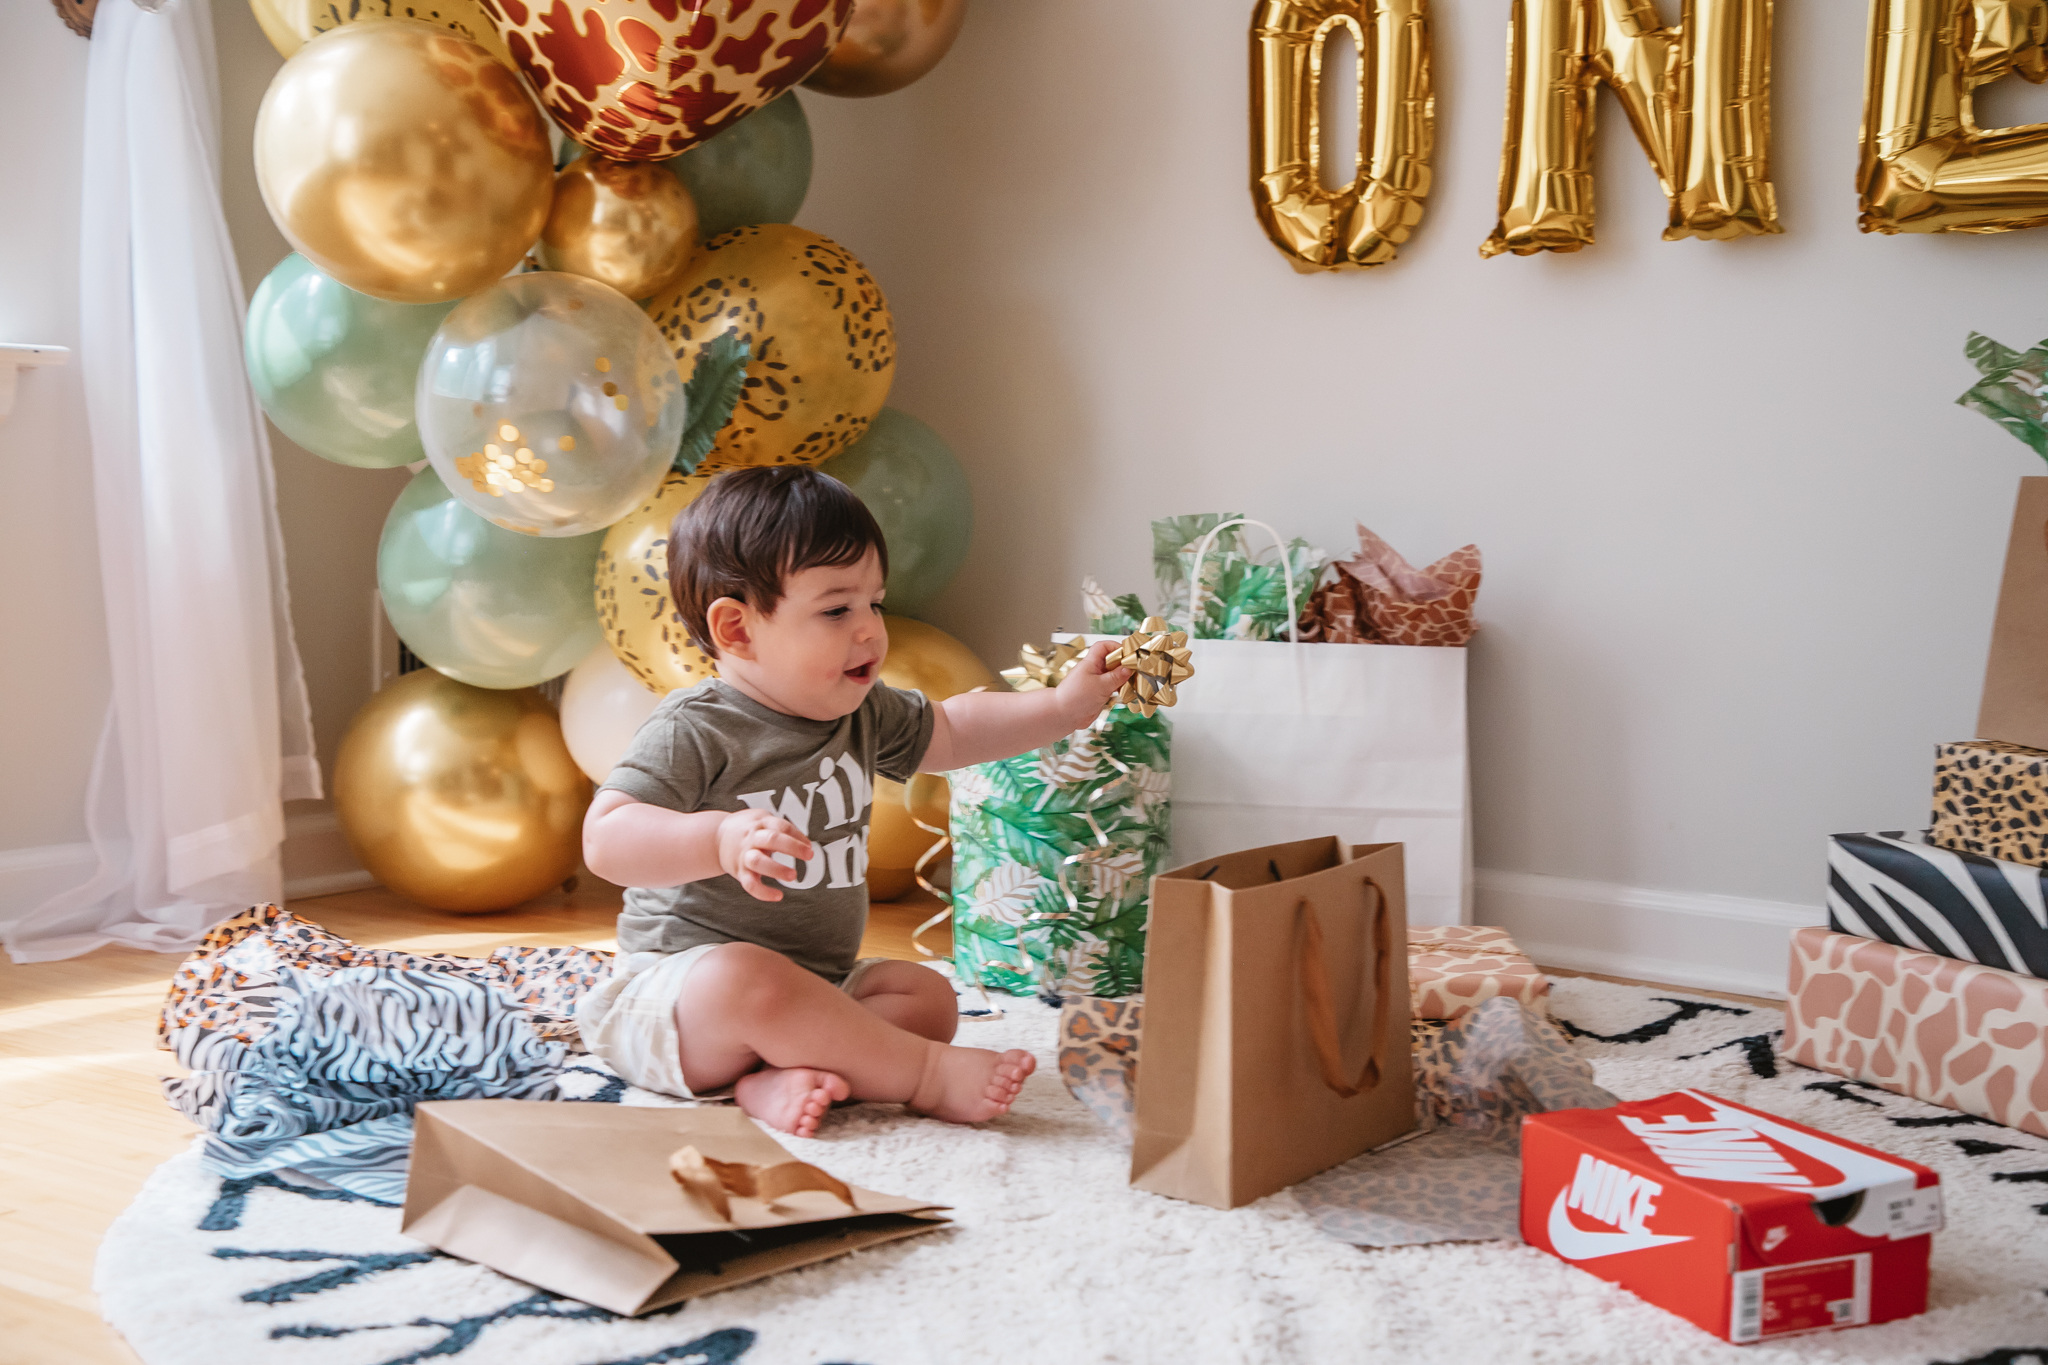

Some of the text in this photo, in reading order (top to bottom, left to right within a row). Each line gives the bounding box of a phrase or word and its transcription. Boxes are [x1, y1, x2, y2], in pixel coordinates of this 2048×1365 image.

[771, 825, 869, 890] on
[1615, 1113, 1813, 1186] NIKE
[1568, 1153, 1663, 1237] NIKE
